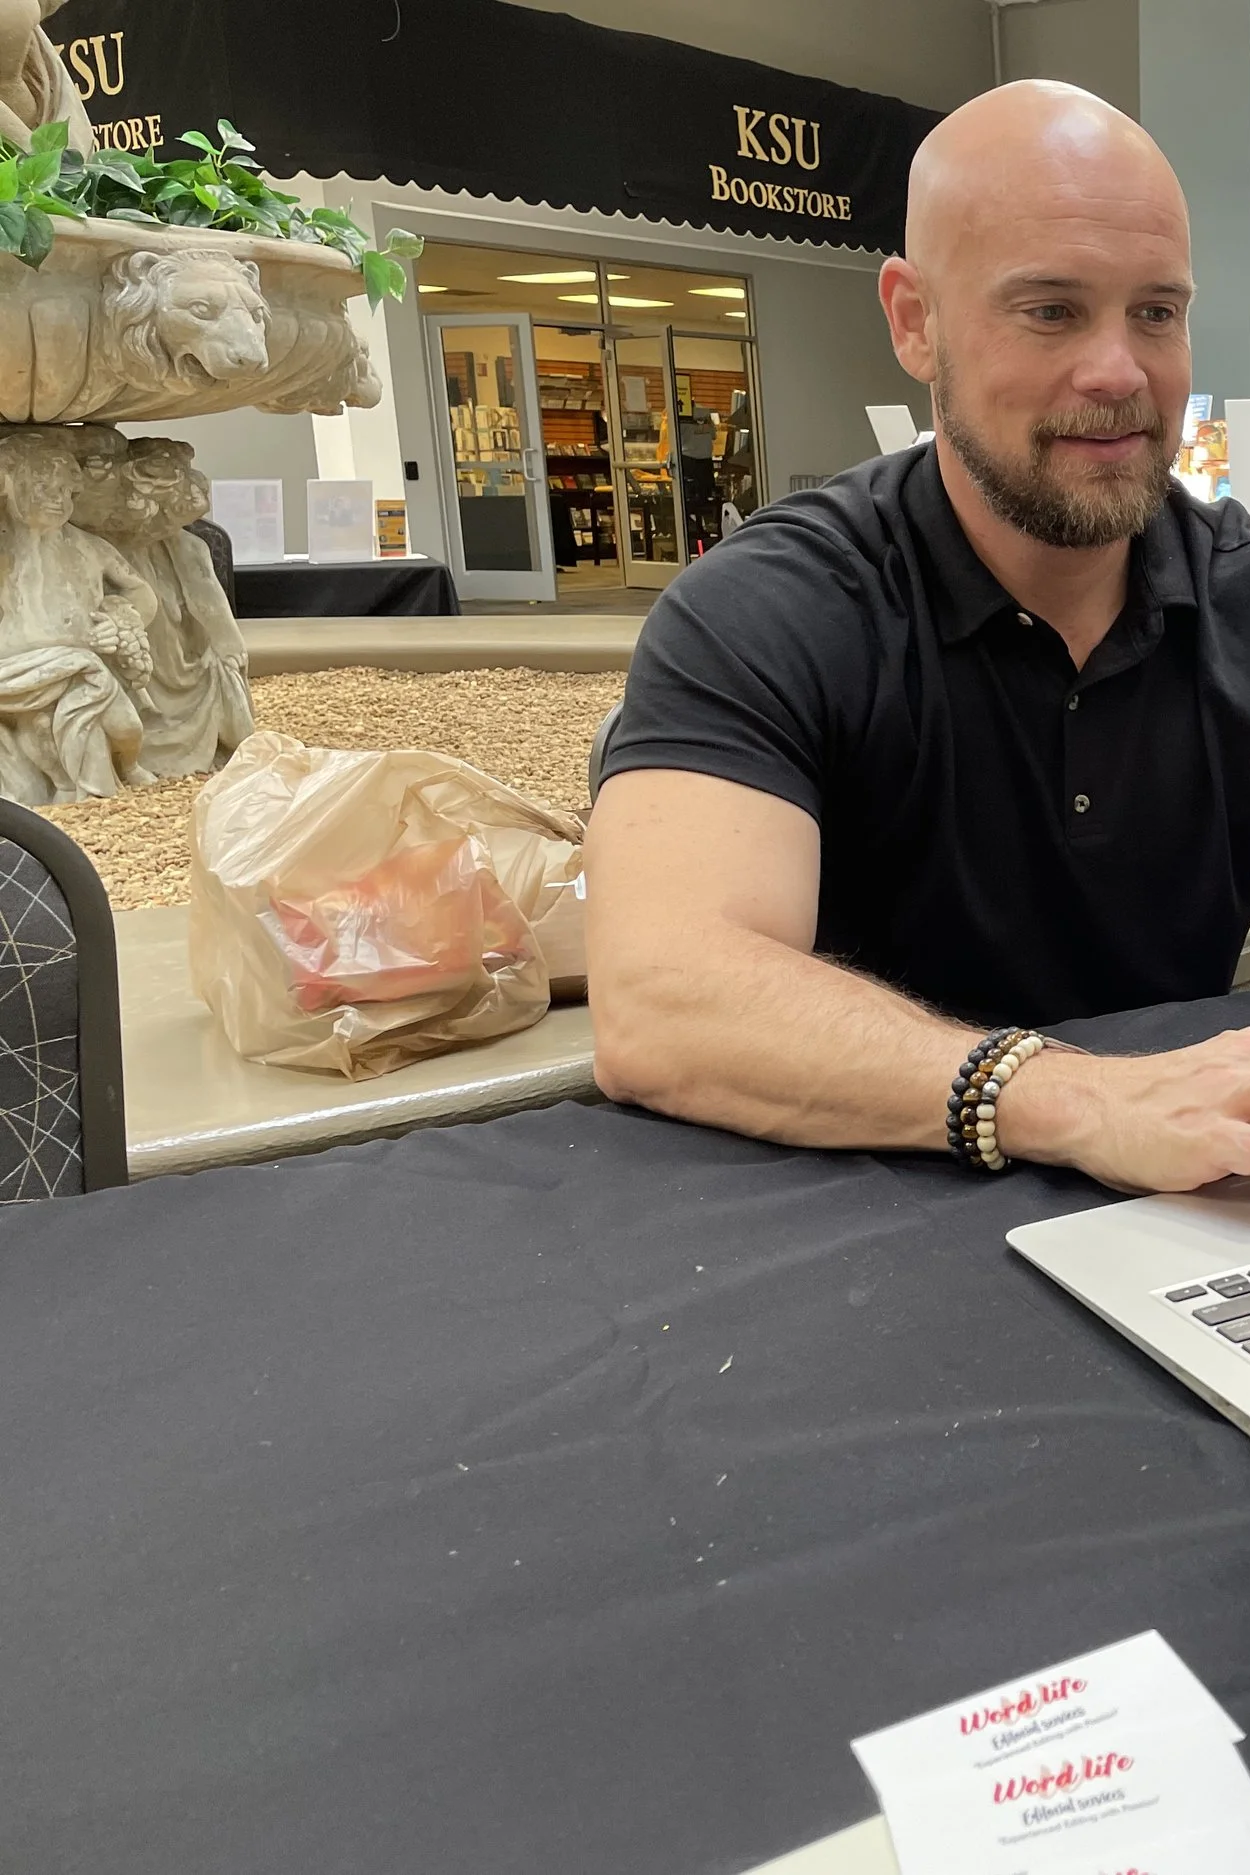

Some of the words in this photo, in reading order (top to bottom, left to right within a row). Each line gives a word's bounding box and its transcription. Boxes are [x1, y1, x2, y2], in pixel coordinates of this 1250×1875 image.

[53, 31, 124, 100] SU
[92, 115, 164, 152] STORE
[733, 105, 820, 170] KSU
[709, 165, 852, 220] BOOKSTORE
[960, 1691, 1036, 1735] Word
[1040, 1677, 1088, 1704] life
[994, 1763, 1078, 1804] Word
[1084, 1752, 1134, 1778] life
[1022, 1798, 1075, 1826] Editorial
[1077, 1788, 1126, 1810] services
